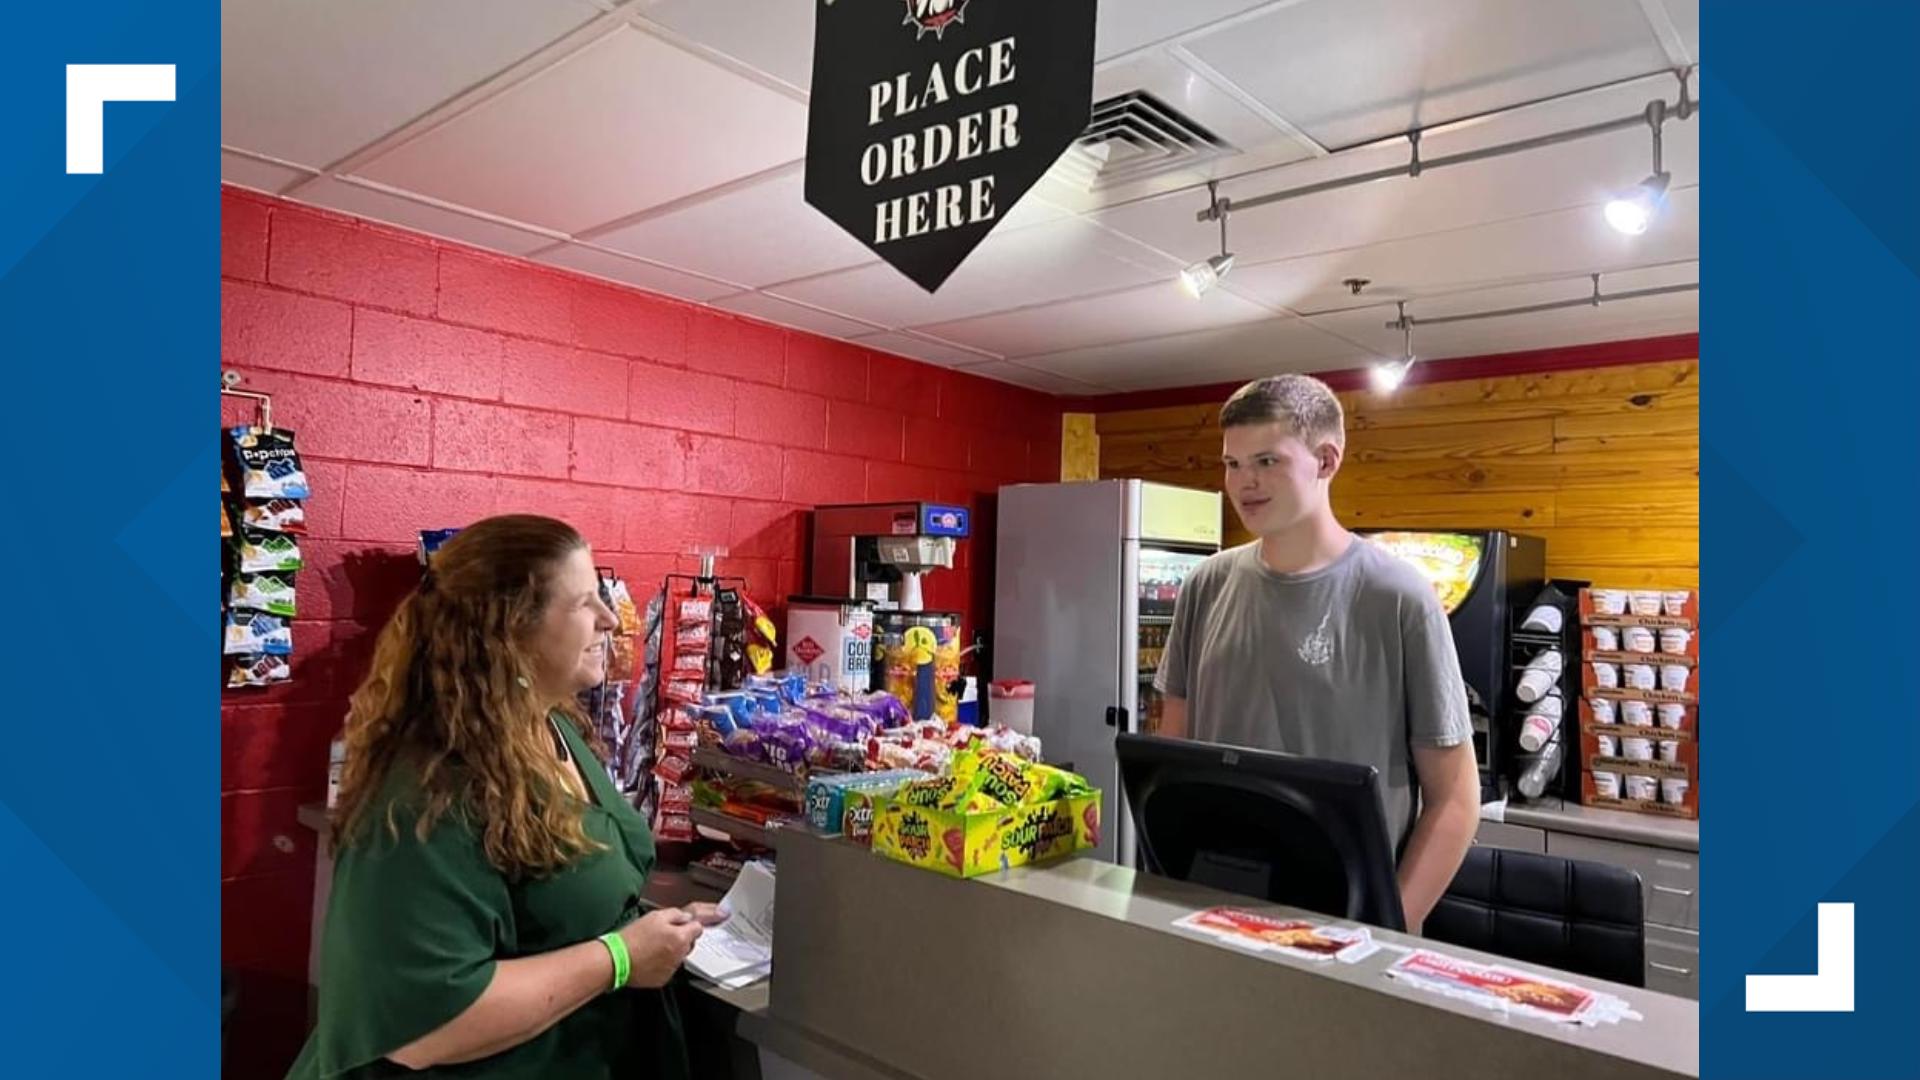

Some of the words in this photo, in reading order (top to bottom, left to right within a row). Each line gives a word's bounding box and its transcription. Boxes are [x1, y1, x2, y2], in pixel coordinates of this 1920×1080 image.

[867, 37, 1017, 126] PLACE
[860, 104, 1022, 187] ORDER
[874, 175, 996, 245] HERE
[1001, 824, 1038, 849] SOUR
